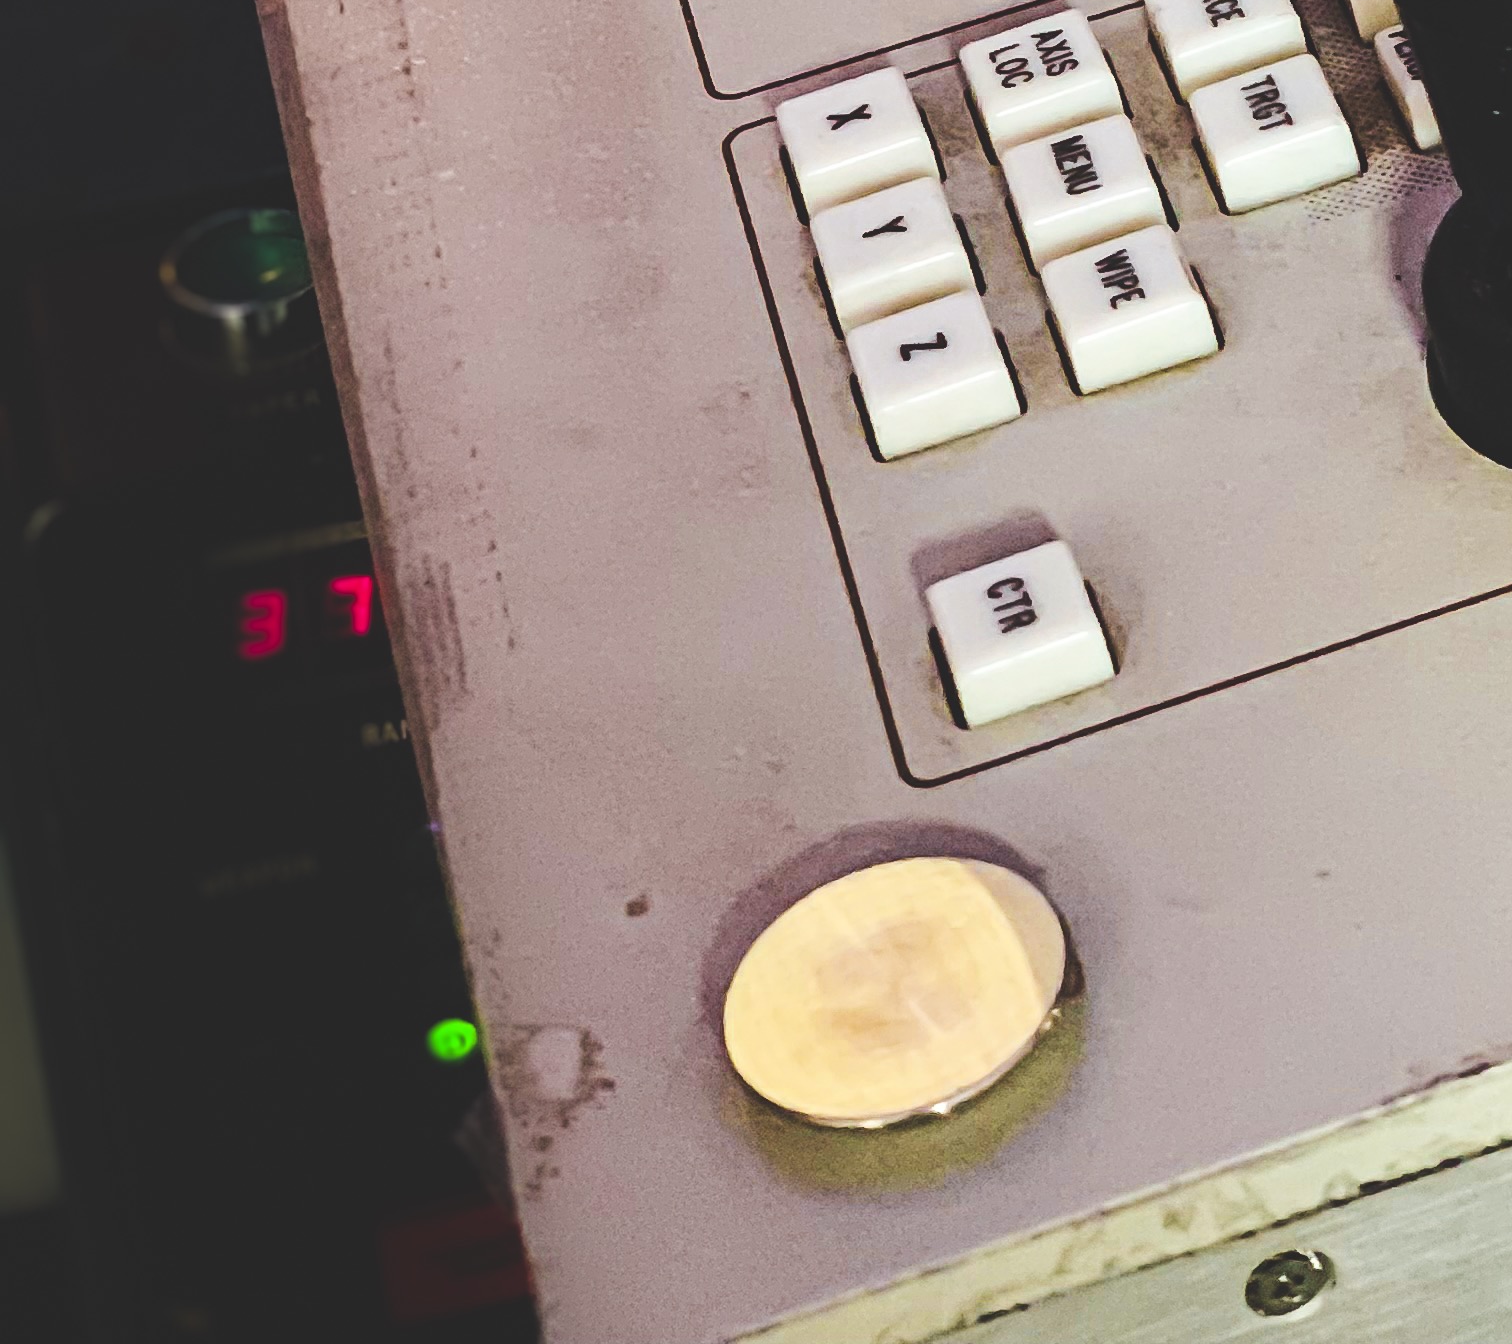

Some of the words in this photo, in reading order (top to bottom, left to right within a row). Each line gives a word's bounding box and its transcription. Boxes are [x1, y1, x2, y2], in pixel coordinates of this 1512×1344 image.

[989, 44, 1034, 88] LOC
[1031, 29, 1079, 76] AXIS
[826, 104, 871, 130] X
[1241, 75, 1293, 130] TRGT
[1051, 135, 1103, 195] MENU
[862, 216, 907, 238] Y
[1095, 249, 1145, 309] WIPE
[900, 332, 947, 361] Z
[987, 578, 1037, 633] CTR
